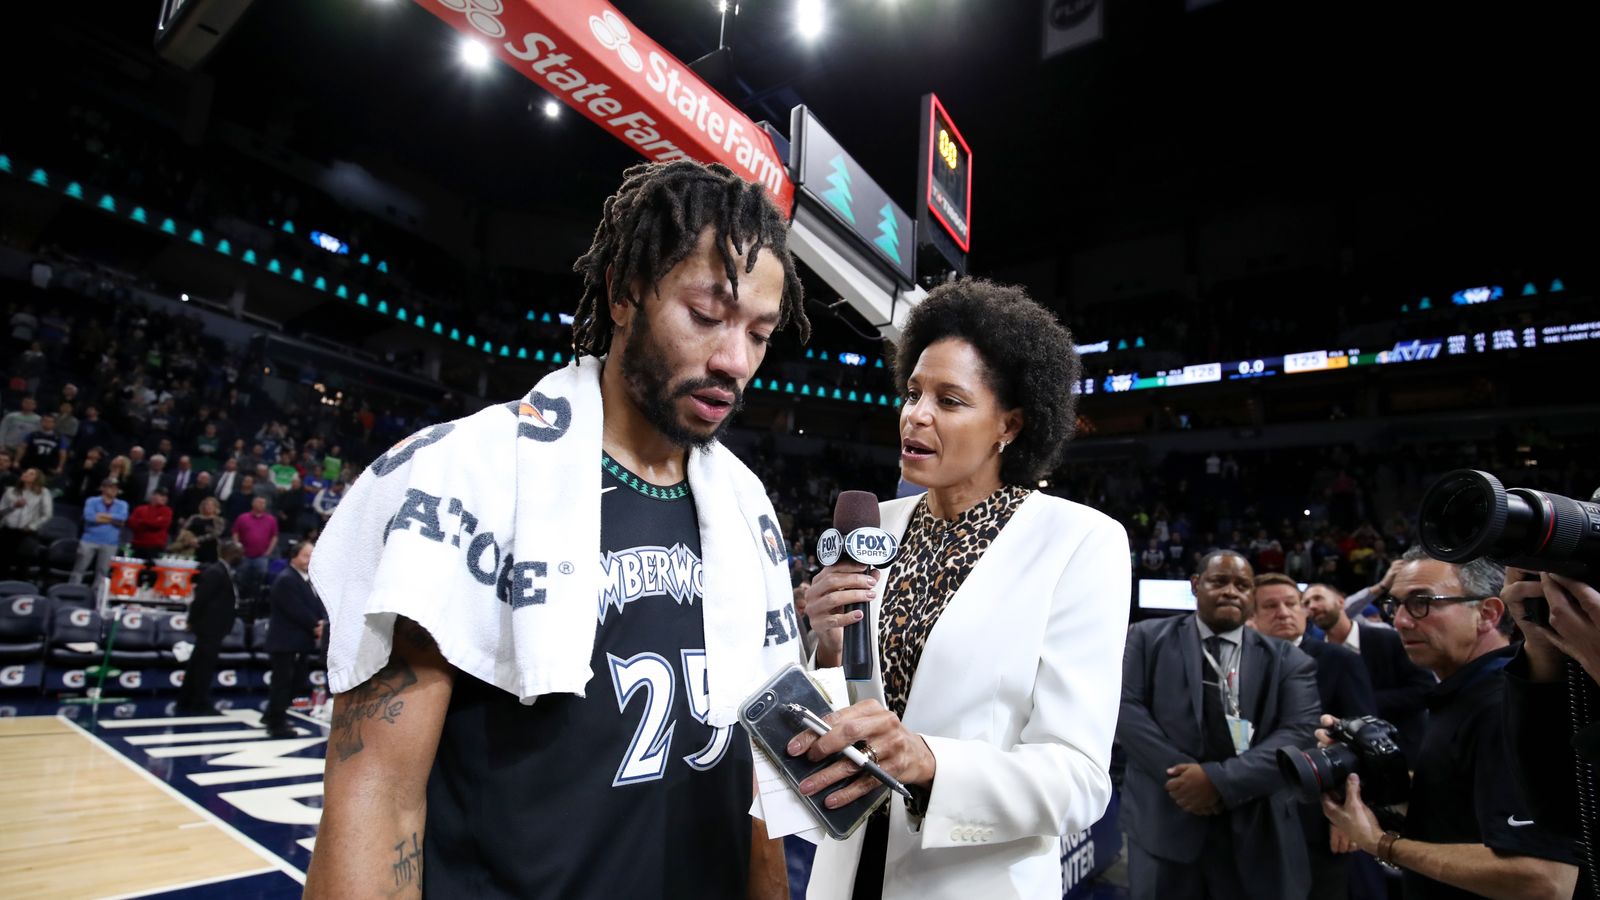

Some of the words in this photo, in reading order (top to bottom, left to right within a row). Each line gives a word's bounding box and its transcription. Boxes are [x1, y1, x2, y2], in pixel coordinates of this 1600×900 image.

[822, 535, 837, 553] FOX
[856, 534, 887, 551] FOX
[821, 549, 837, 560] SPORTS
[856, 549, 888, 558] SPORTS
[70, 610, 91, 627] G
[122, 613, 142, 629] G
[62, 670, 86, 688] G
[119, 671, 142, 689] G
[217, 670, 237, 687] G
[1061, 840, 1095, 897] NTER
